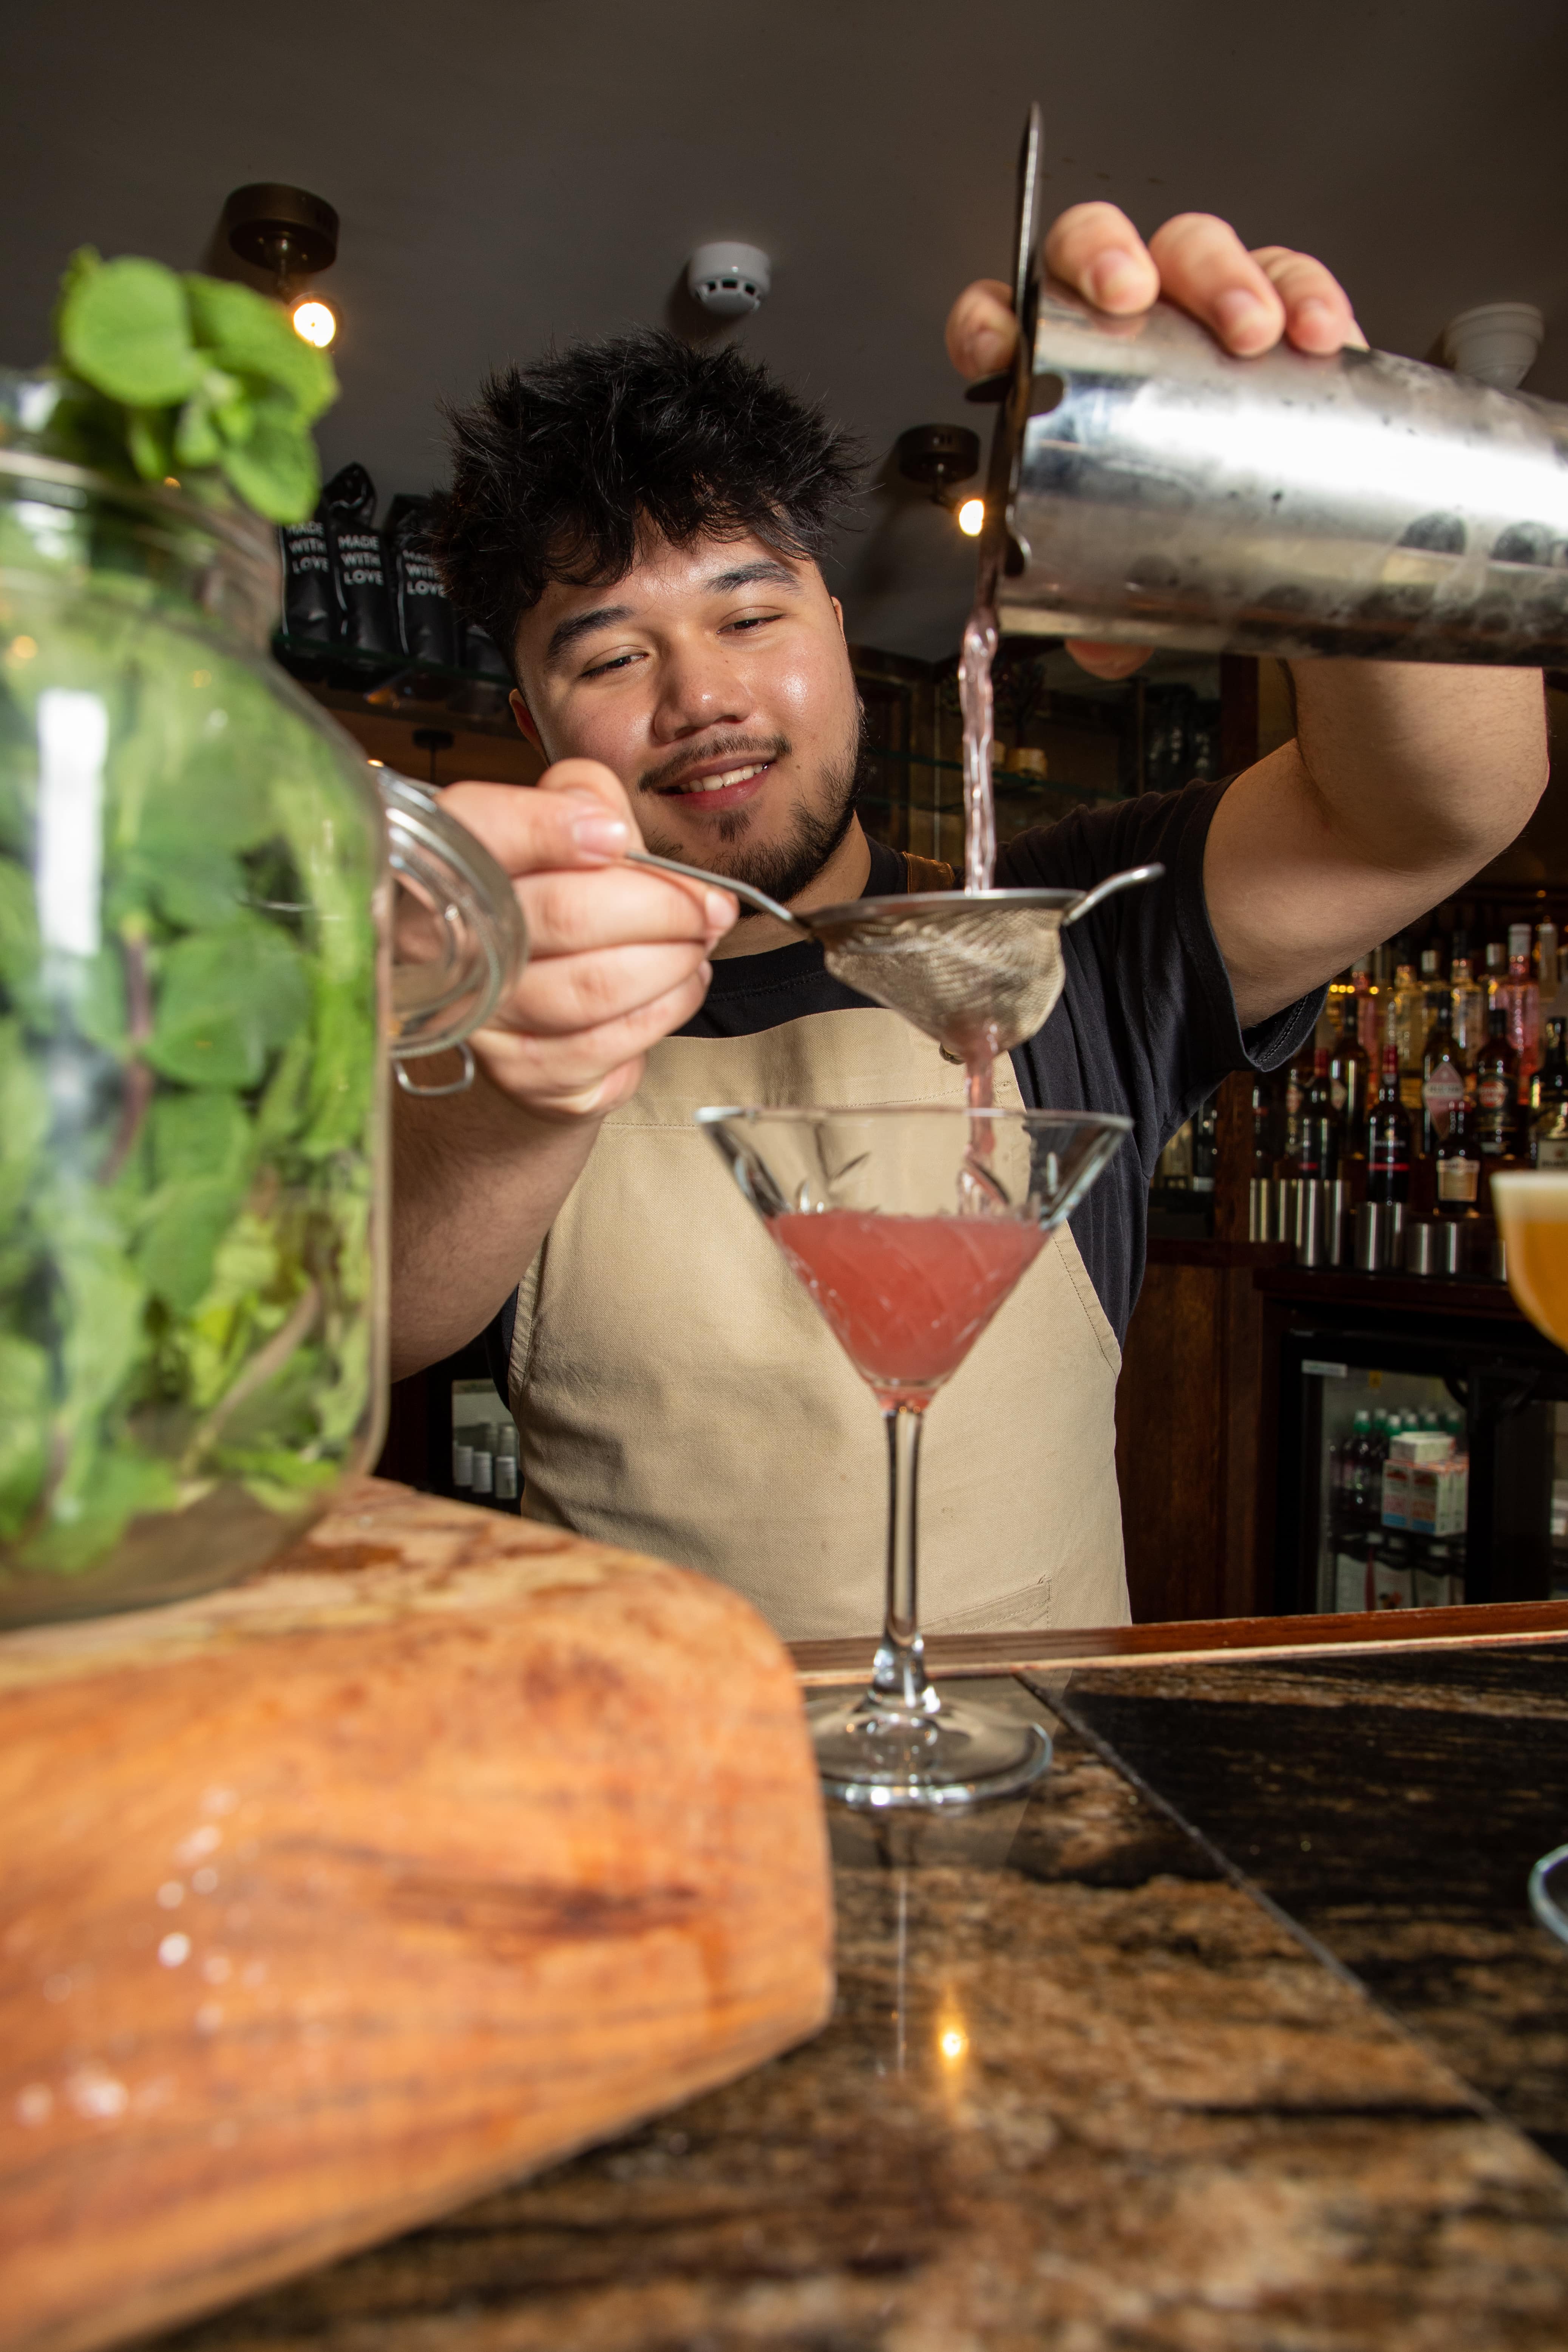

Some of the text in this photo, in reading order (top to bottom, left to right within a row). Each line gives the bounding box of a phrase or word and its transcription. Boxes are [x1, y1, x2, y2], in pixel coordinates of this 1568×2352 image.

[289, 538, 327, 554] WITH
[338, 534, 380, 551] MADE
[292, 556, 329, 574] LOVE
[341, 552, 381, 568] WITH
[344, 570, 384, 586] LOVE
[405, 563, 440, 581] WIT
[407, 580, 447, 598] LOVE
